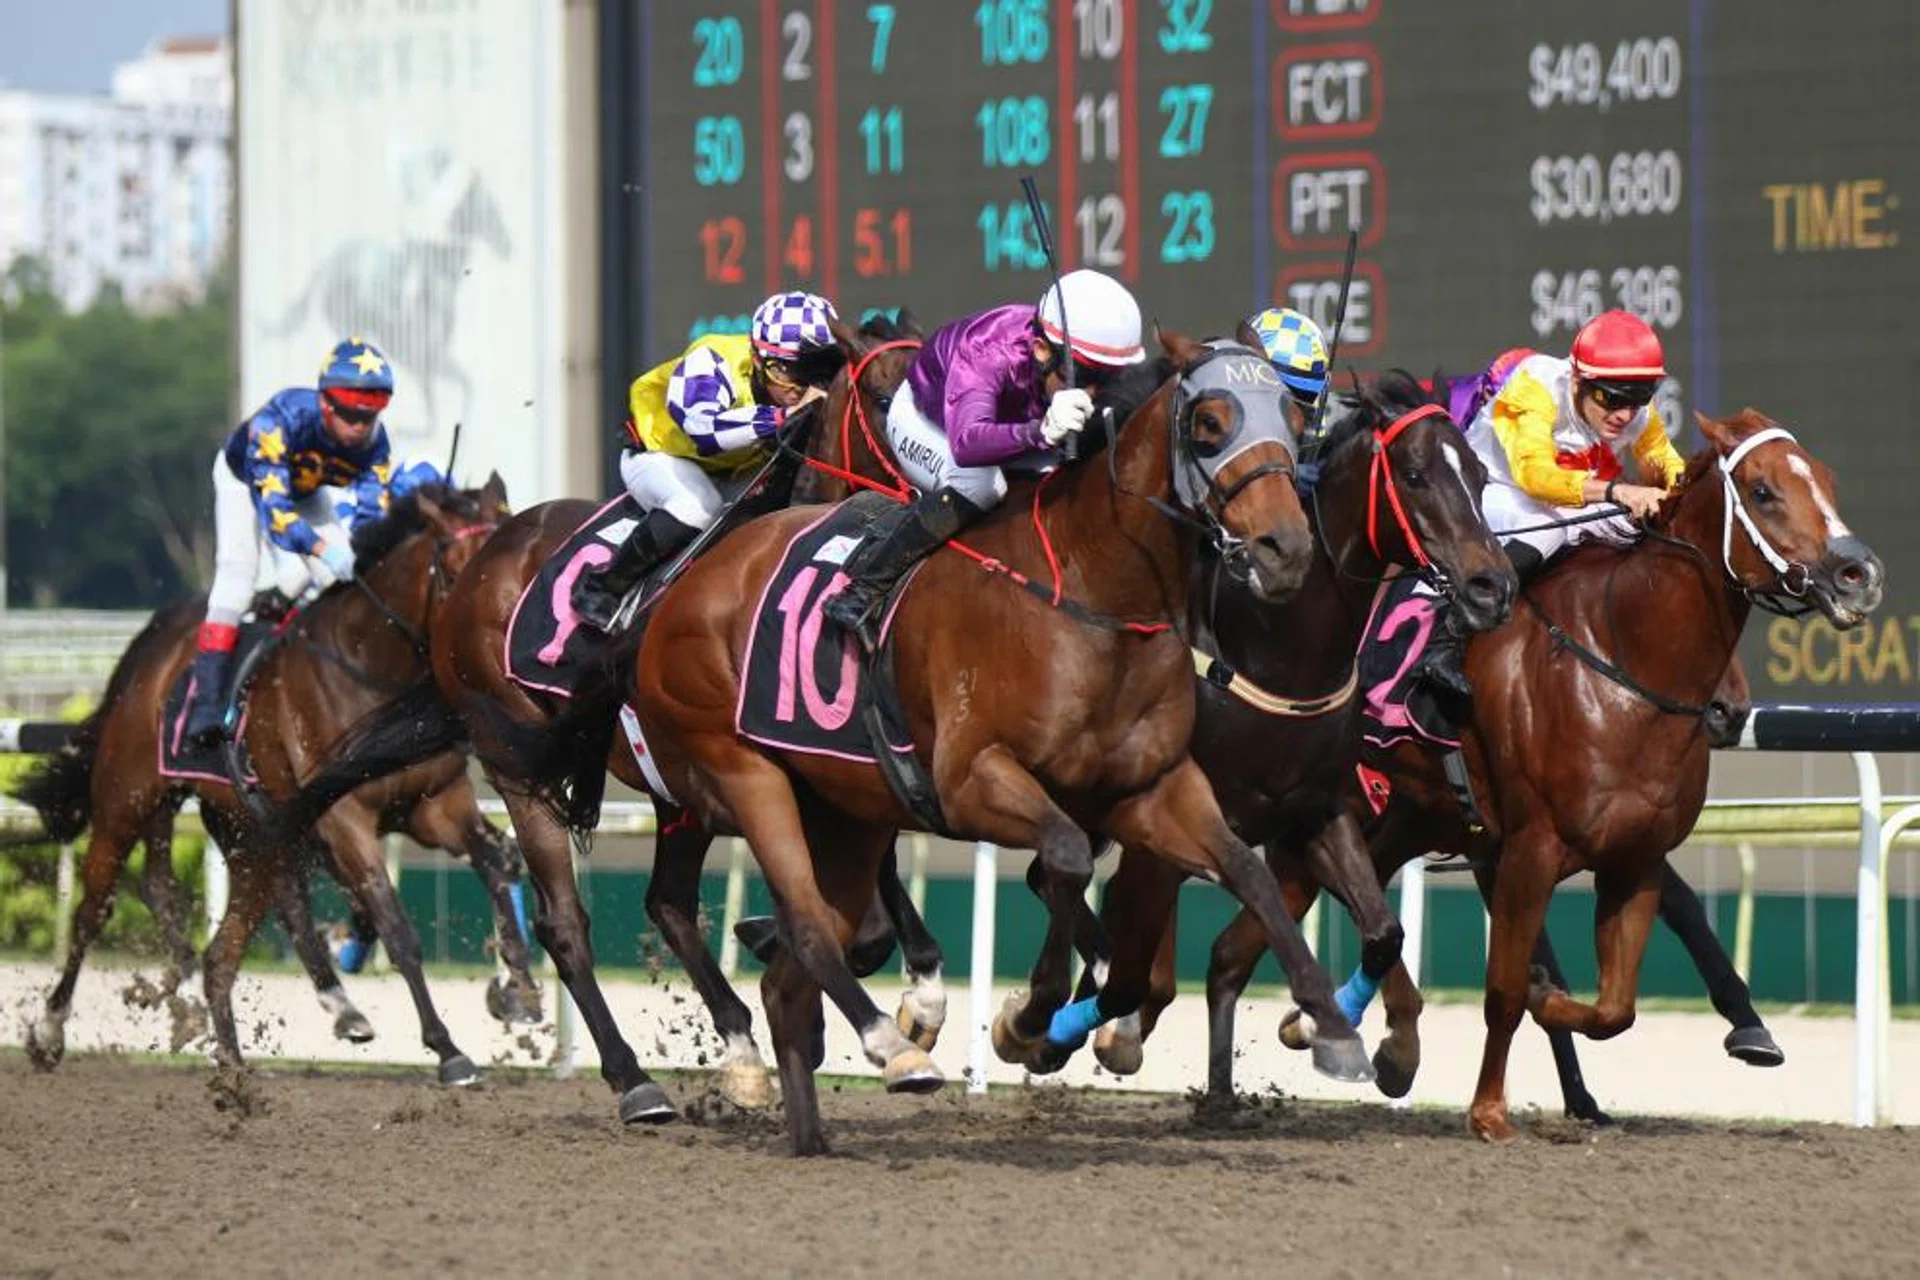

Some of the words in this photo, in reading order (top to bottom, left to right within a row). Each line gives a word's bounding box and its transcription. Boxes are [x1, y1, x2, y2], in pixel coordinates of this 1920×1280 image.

[692, 17, 743, 87] 20
[782, 11, 812, 81] 2
[867, 4, 896, 74] 7
[974, 0, 1049, 65] 106
[1074, 0, 1125, 59] 10
[1289, 60, 1369, 126] FCT
[1529, 36, 1681, 113] $49,400
[694, 115, 745, 186] 50
[784, 111, 814, 182] 3
[858, 105, 903, 176] 11
[976, 96, 1050, 167] 108
[1073, 92, 1120, 164] 11
[1159, 83, 1213, 158] 27
[1076, 195, 1126, 267] 12
[1160, 190, 1215, 264] 23
[1291, 169, 1369, 235] PFT
[1530, 149, 1681, 226] $30,680
[1763, 178, 1900, 254] TIME:
[700, 216, 746, 283] 12
[786, 215, 813, 281] 4
[855, 207, 911, 278] 5.1
[1288, 279, 1371, 343] TCE
[1531, 264, 1682, 338] $46396
[776, 566, 860, 731] 10
[1363, 597, 1436, 727] 2
